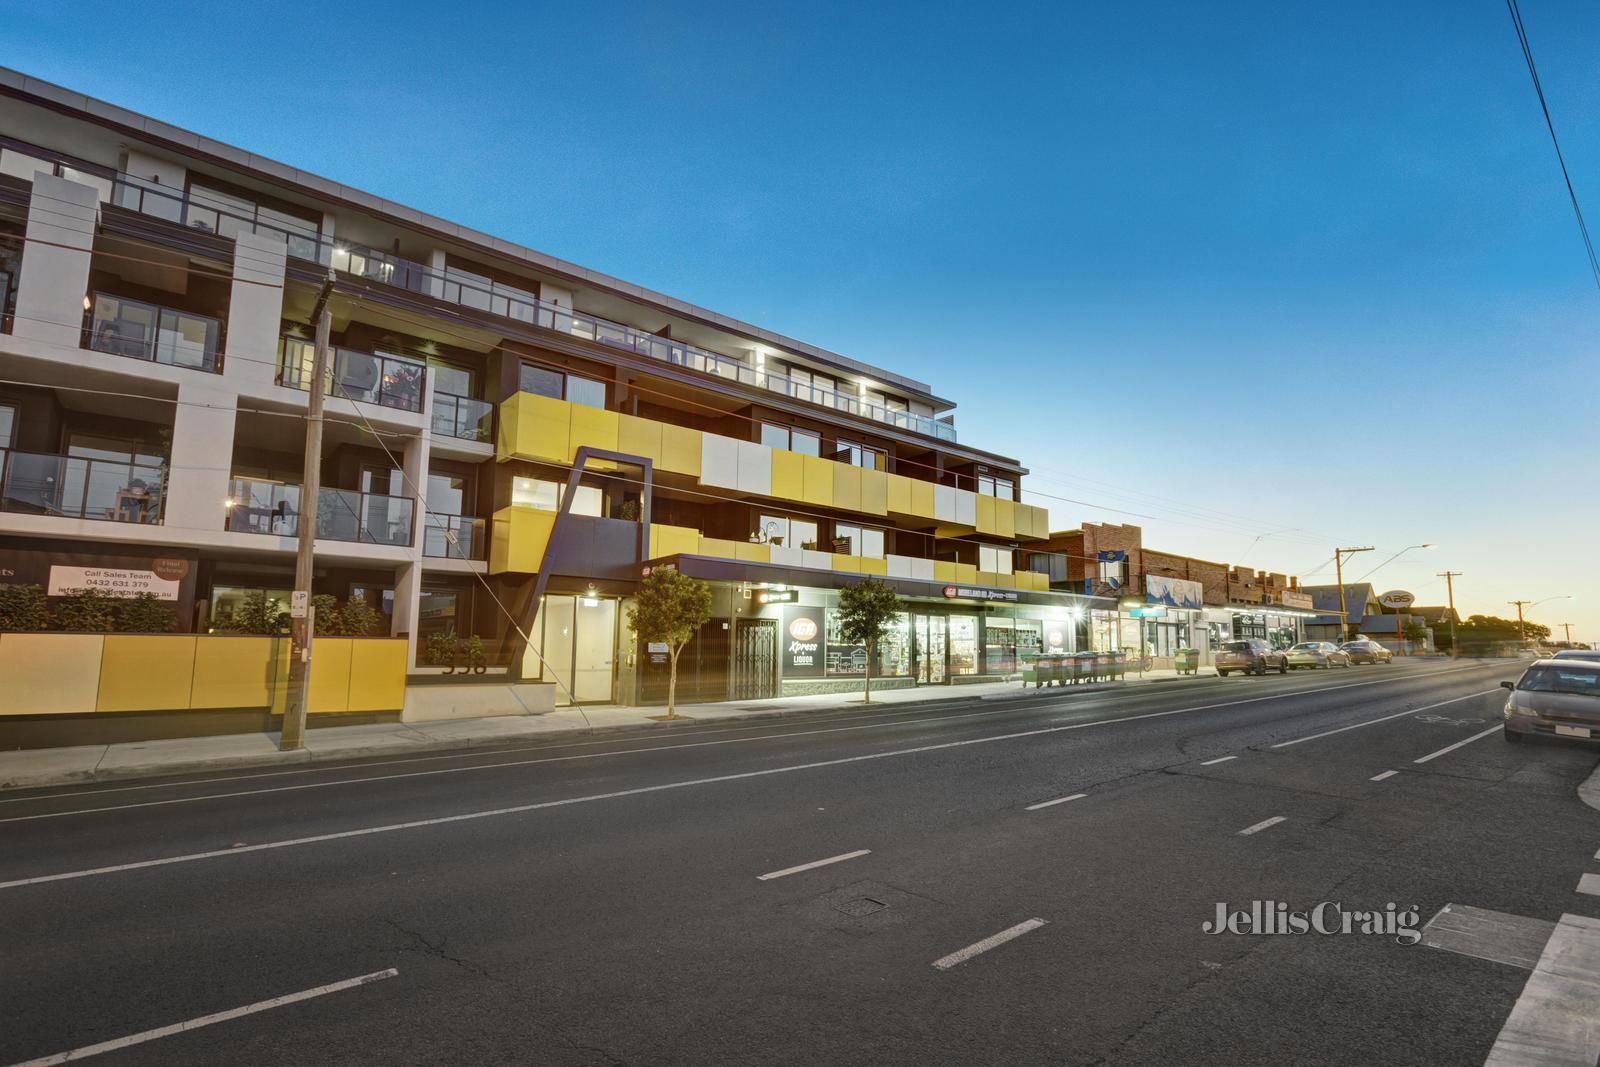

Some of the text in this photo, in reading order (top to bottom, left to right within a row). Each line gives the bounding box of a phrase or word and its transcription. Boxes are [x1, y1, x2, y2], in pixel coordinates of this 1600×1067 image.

[103, 571, 129, 579] Sales
[129, 572, 152, 580] Team
[1383, 594, 1410, 603] ABS
[793, 623, 814, 635] IGA
[788, 641, 818, 652] Xpress
[793, 655, 813, 664] LIQUOR
